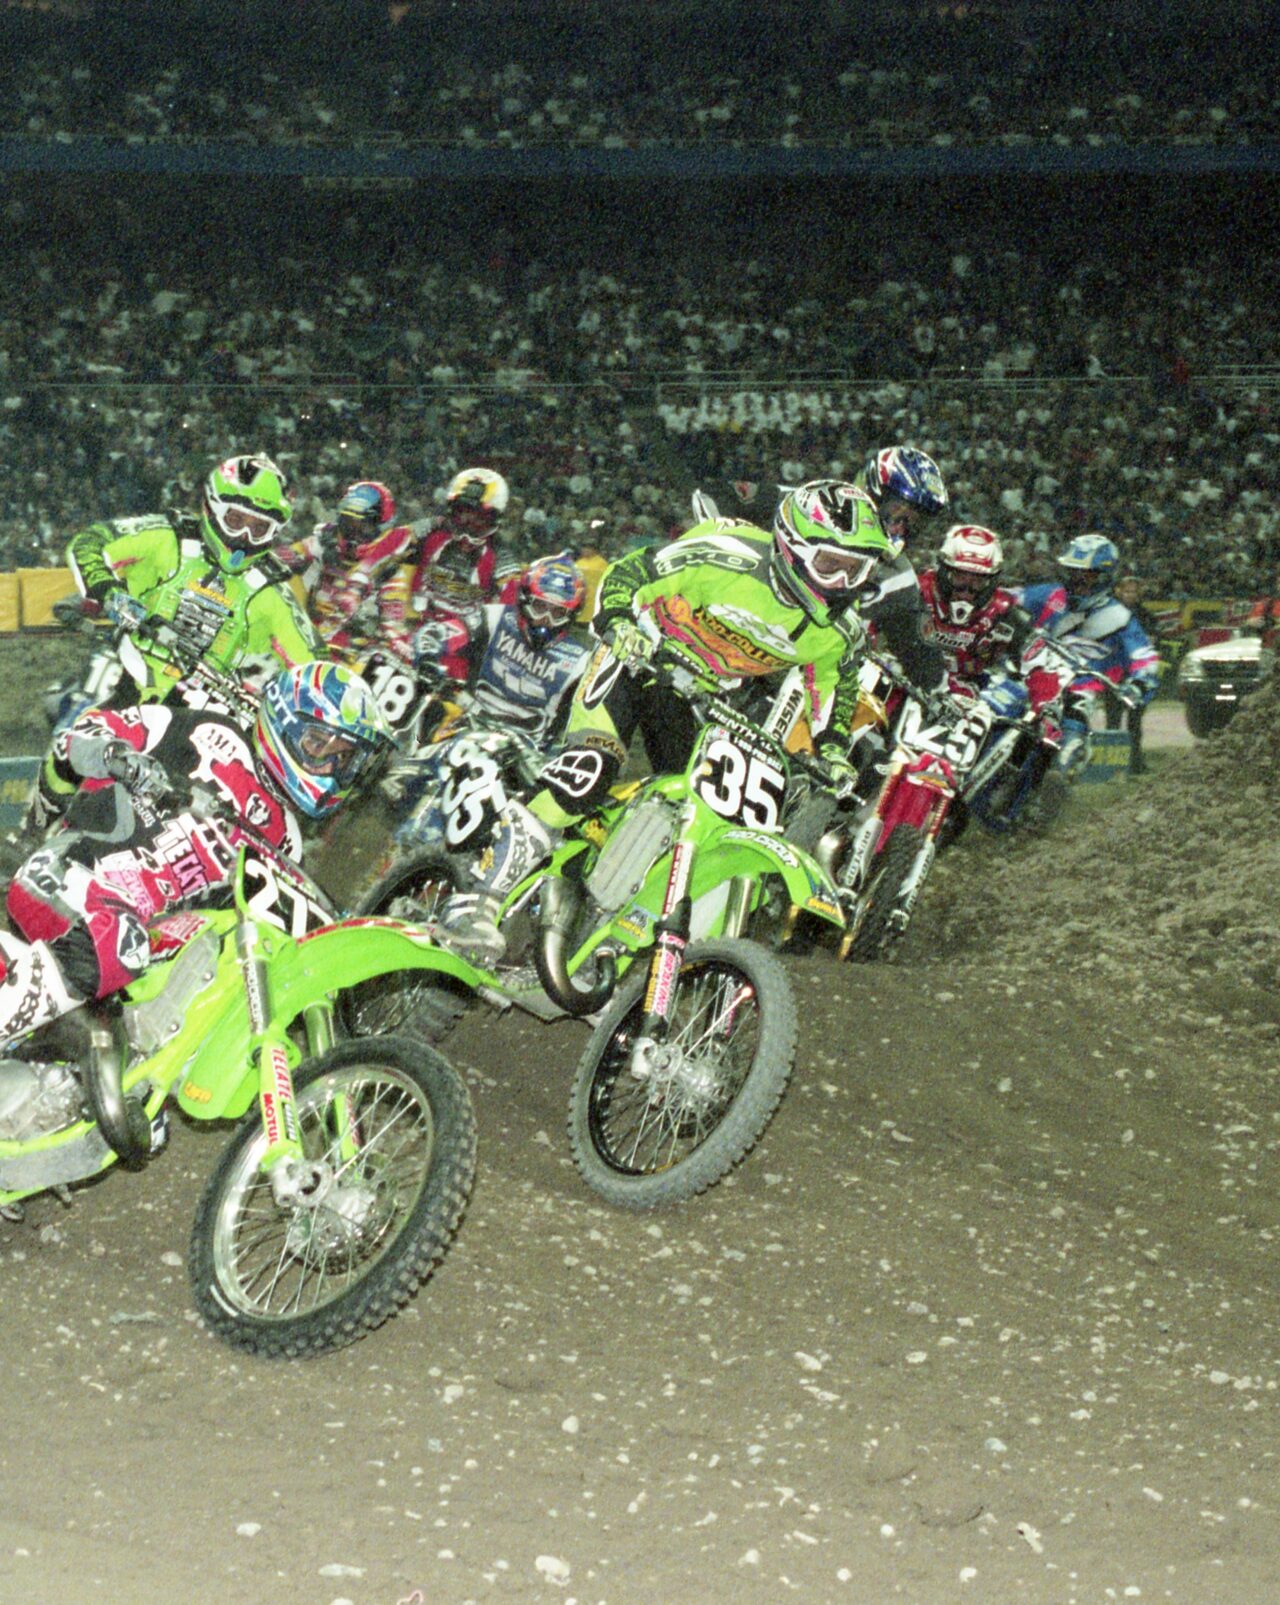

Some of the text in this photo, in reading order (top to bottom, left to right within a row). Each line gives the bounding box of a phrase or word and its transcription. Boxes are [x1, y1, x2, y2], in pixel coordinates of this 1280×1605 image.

[492, 630, 557, 682] YAMAHA
[367, 664, 415, 724] 18
[699, 740, 786, 833] 35
[263, 1093, 281, 1145] MOTUL
